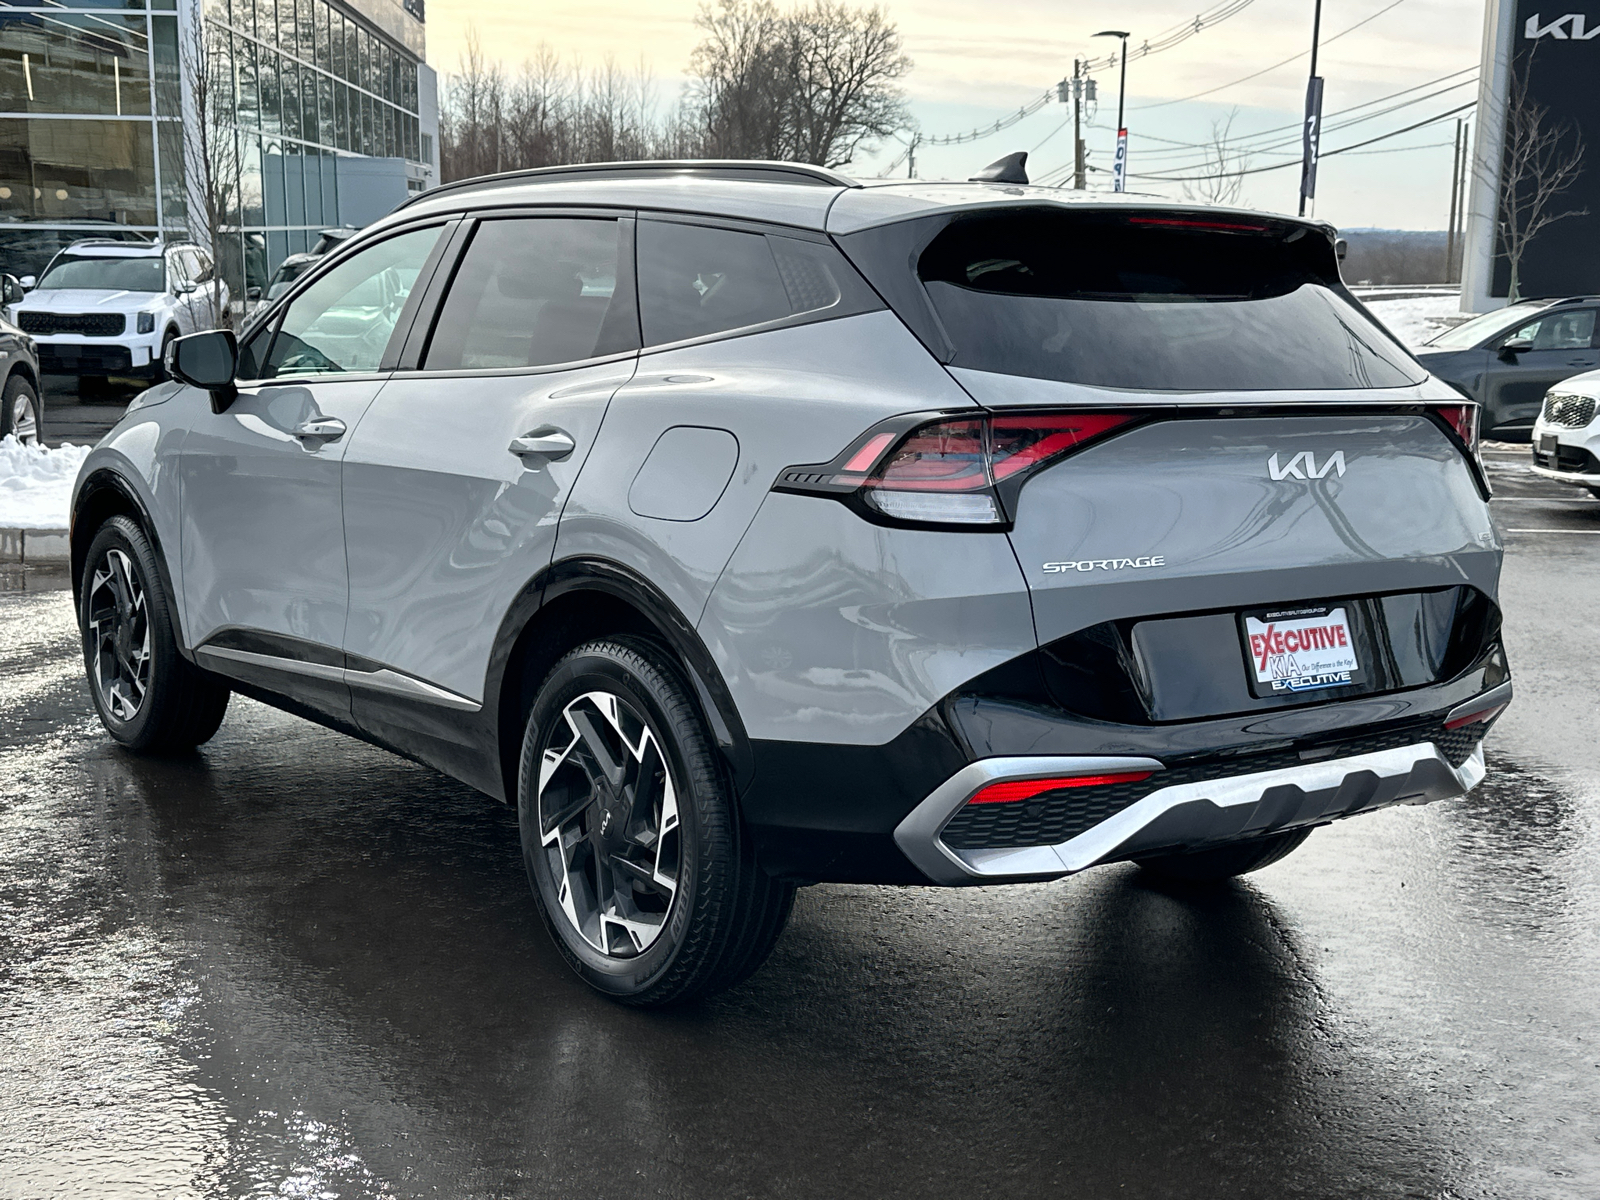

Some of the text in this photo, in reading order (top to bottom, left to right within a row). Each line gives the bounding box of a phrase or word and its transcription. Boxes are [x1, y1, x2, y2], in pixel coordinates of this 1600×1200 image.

[1268, 450, 1346, 481] KIA
[1042, 555, 1166, 574] SPORTAGE
[1250, 623, 1347, 673] EXECUTIVE
[1269, 654, 1302, 679] KIA
[1301, 663, 1310, 672] Our
[1311, 661, 1332, 673] Difference
[1271, 671, 1352, 690] EXECUTIVE
